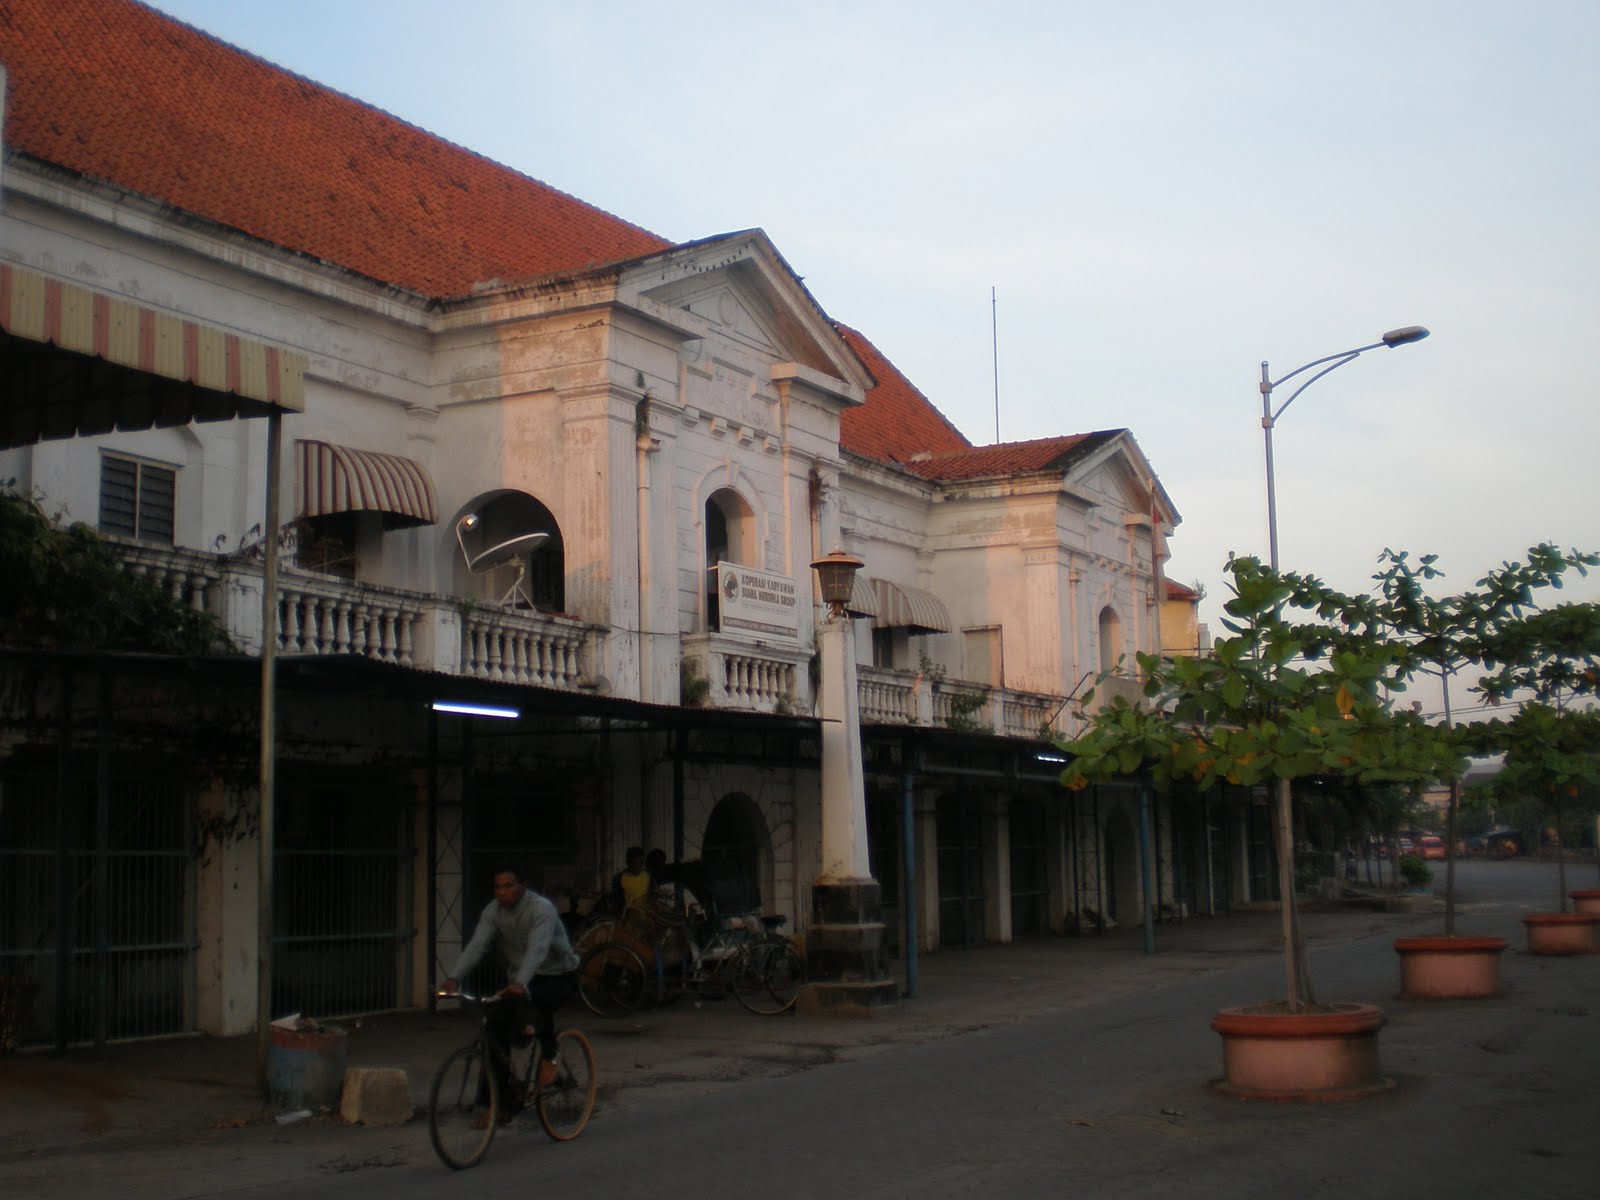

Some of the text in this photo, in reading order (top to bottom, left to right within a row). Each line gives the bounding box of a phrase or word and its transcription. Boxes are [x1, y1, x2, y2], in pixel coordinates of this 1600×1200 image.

[741, 575, 795, 594] KOPERASI KARYAWAN
[741, 588, 757, 600] SUARA
[758, 591, 780, 604] MERDEKA
[780, 595, 796, 608] GROUP
